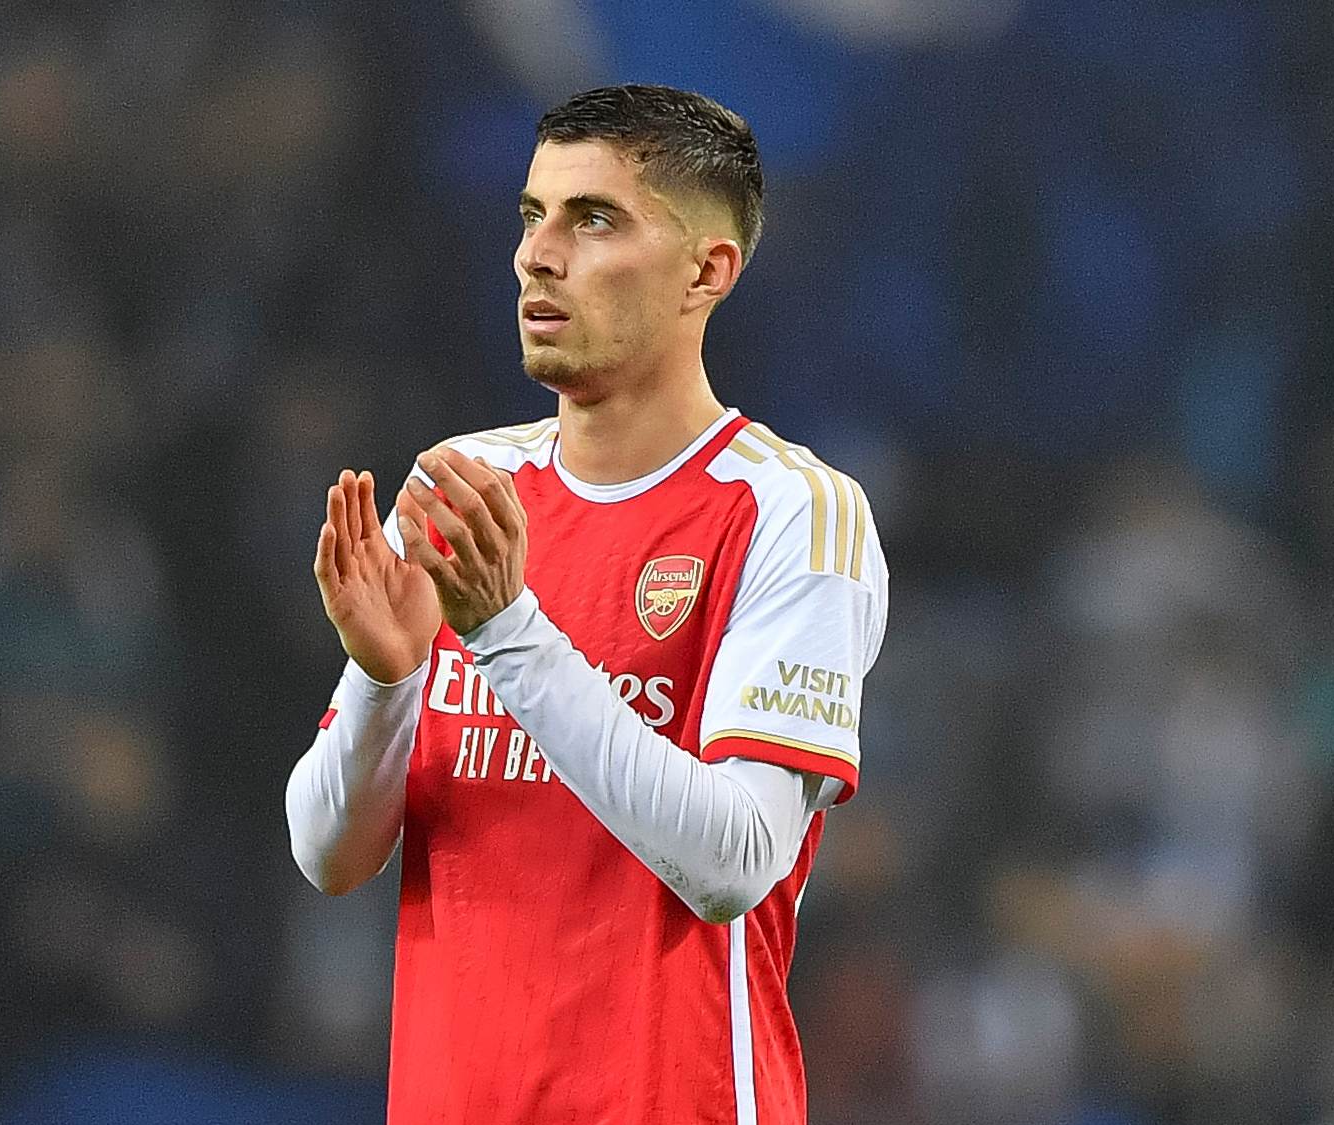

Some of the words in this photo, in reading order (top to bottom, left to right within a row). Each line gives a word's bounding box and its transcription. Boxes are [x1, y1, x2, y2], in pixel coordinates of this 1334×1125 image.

[647, 569, 693, 582] Arsenal
[777, 660, 851, 698] VISIT
[739, 685, 857, 732] RWAND
[452, 727, 499, 779] FLY
